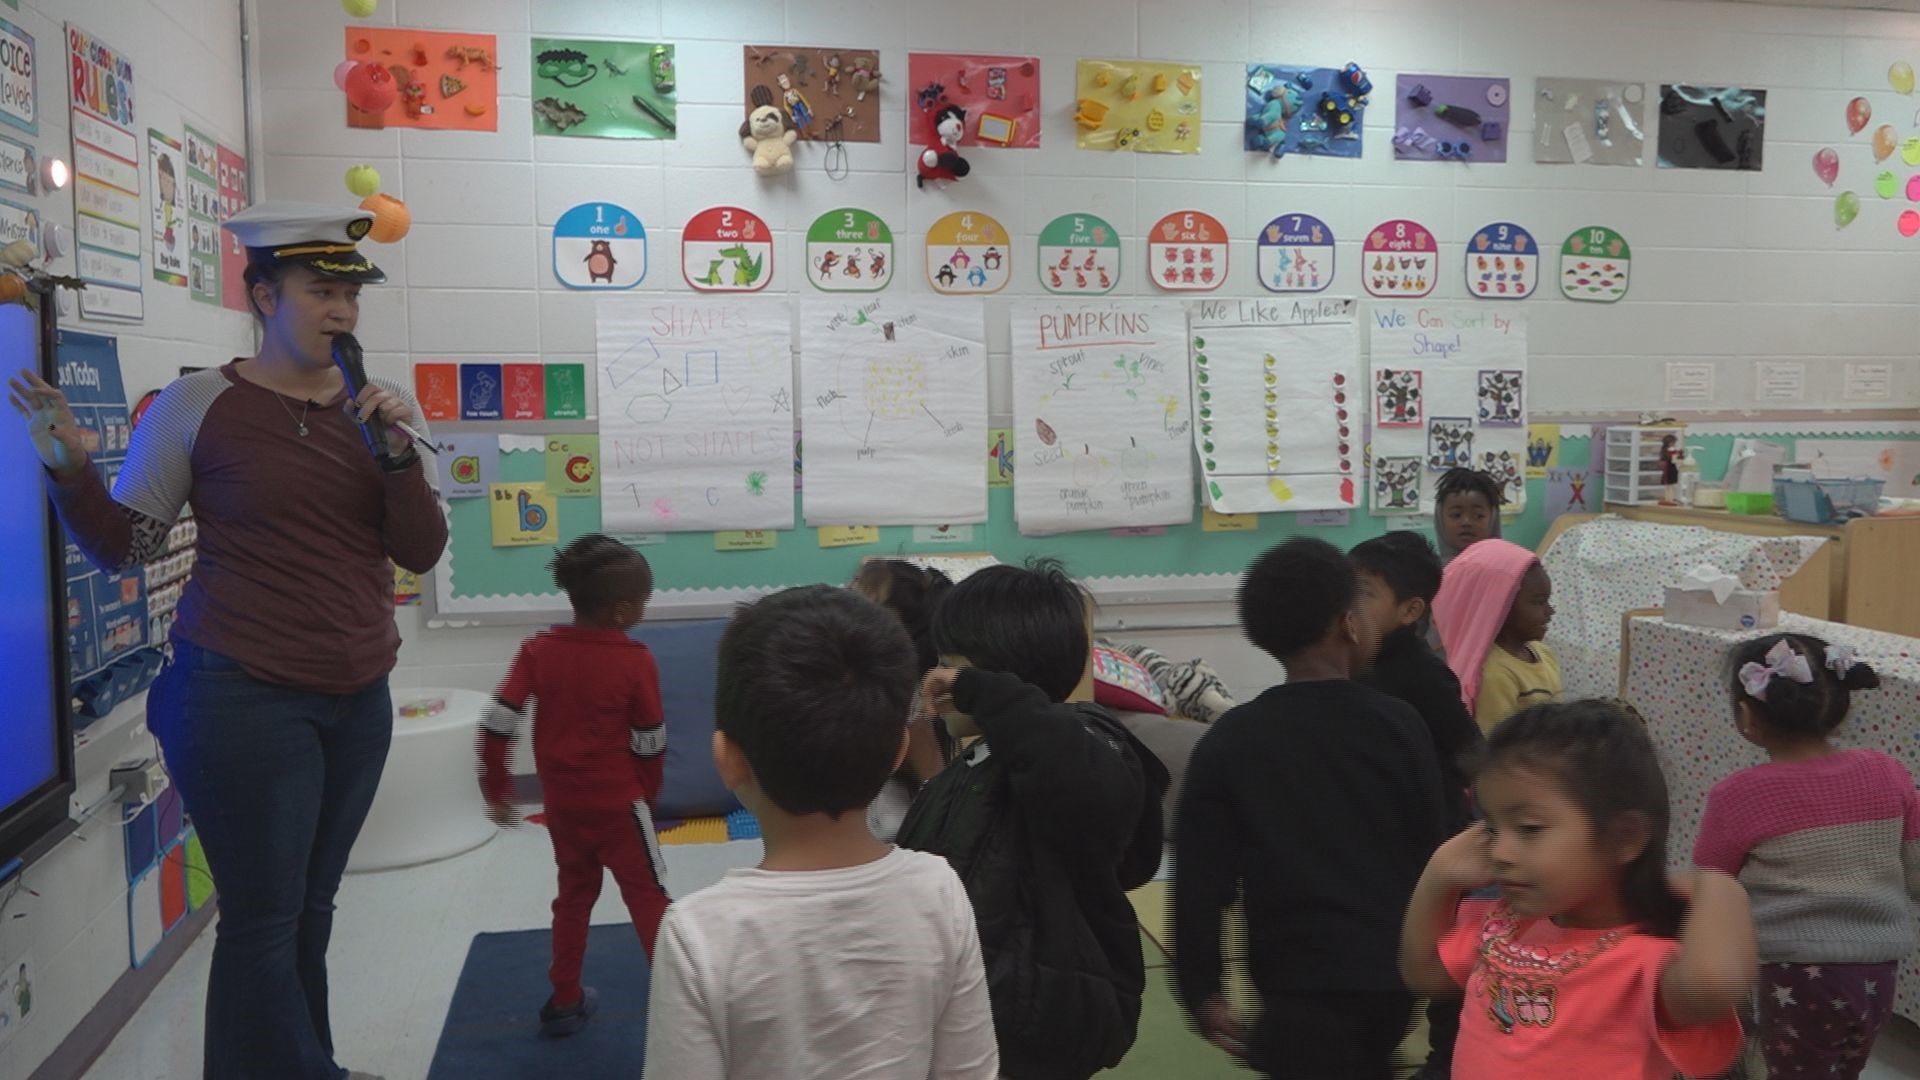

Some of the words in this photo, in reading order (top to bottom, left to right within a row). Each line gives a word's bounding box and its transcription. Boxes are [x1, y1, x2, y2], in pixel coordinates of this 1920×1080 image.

[595, 206, 604, 223] 1
[721, 211, 733, 227] 2
[844, 212, 855, 228] 3
[1183, 213, 1194, 230] 6
[589, 225, 610, 235] one
[961, 215, 973, 231] 4
[1074, 217, 1085, 233] 5
[1291, 216, 1302, 232] 7
[1395, 223, 1406, 239] 8
[716, 228, 738, 239] two
[835, 229, 863, 240] three
[956, 231, 979, 242] four
[1069, 233, 1090, 245] five
[1180, 231, 1196, 241] six
[1283, 233, 1310, 242] seven
[1498, 225, 1509, 241] 9
[1589, 229, 1605, 245] 10
[1388, 239, 1412, 251] eight
[1200, 300, 1227, 321] We
[1238, 300, 1279, 323] Like
[650, 304, 749, 337] SHAPES
[1374, 308, 1406, 329] We
[1417, 308, 1443, 329] Can
[1493, 312, 1511, 335] by
[1040, 311, 1150, 347] PUMPKINS
[1412, 332, 1461, 359] Shape!
[1050, 350, 1086, 376] sprout
[614, 434, 666, 469] NOT
[684, 426, 780, 457] SHAPES
